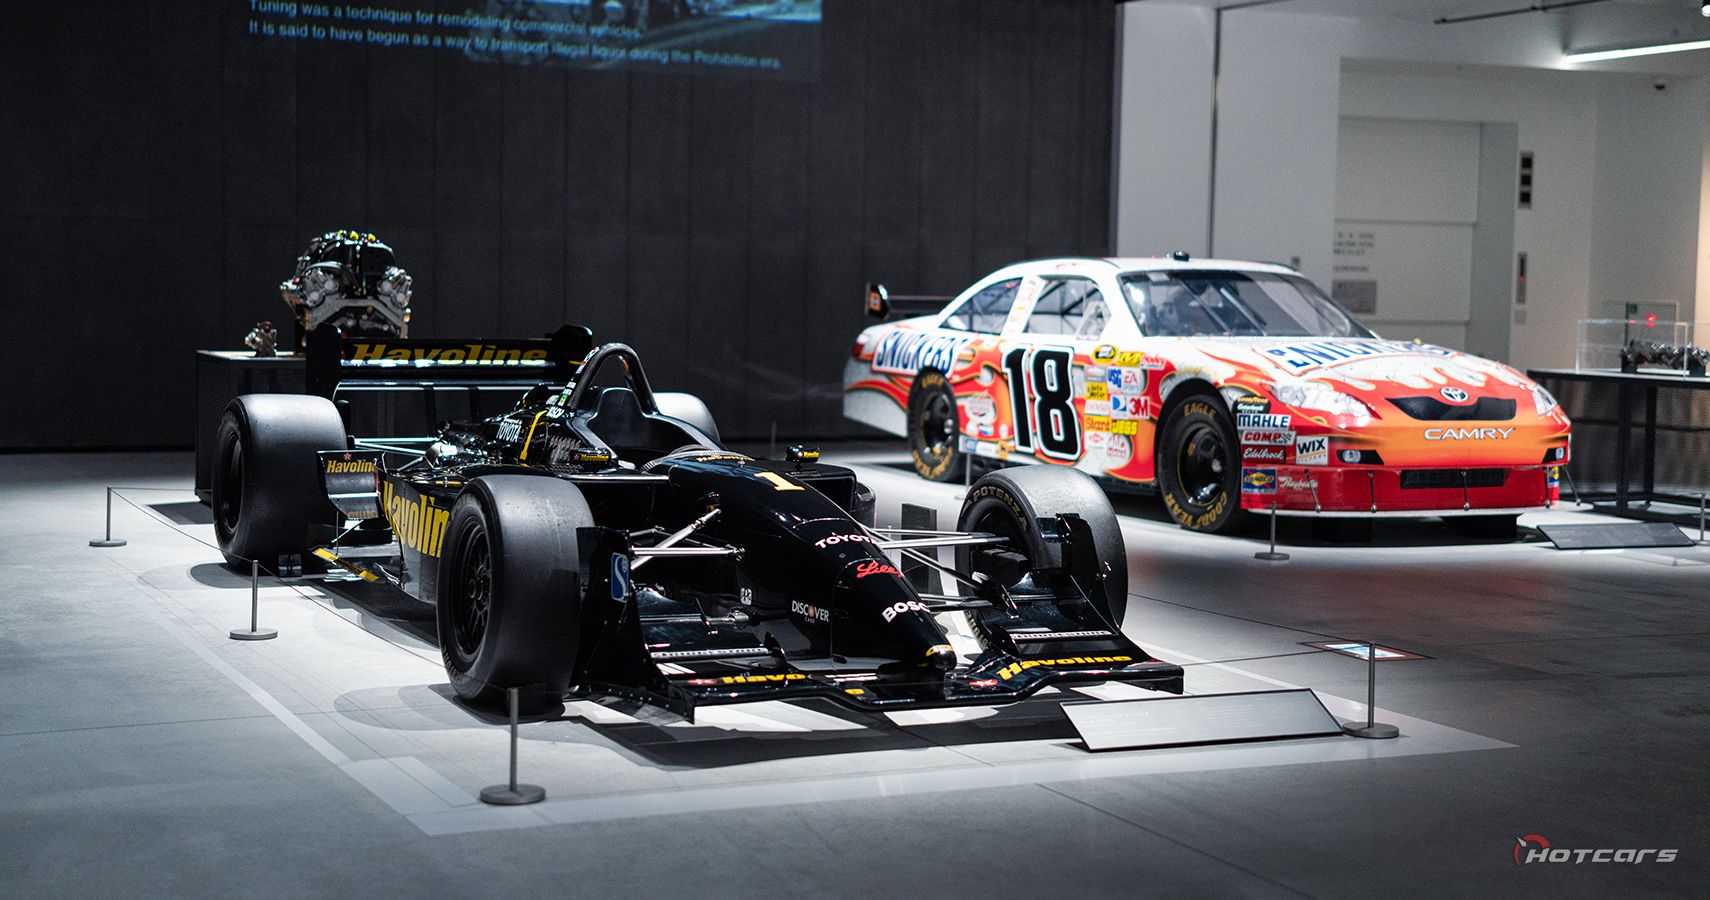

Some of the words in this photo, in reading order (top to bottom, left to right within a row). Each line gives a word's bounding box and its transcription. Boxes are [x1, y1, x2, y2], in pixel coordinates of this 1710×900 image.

[250, 0, 298, 18] Tuning
[302, 3, 330, 17] was
[333, 6, 342, 18] a
[346, 5, 413, 25] technique
[415, 9, 434, 25] for
[437, 13, 511, 33] remodeling
[249, 19, 259, 34] It
[263, 21, 275, 35] is
[279, 22, 309, 38] said
[312, 25, 327, 39] to
[330, 25, 364, 42] have
[367, 28, 410, 48] begun
[413, 33, 430, 46] as
[433, 35, 442, 48] a
[445, 36, 472, 54] way
[475, 36, 489, 51] to
[490, 37, 549, 55] transport
[671, 49, 692, 64] the
[352, 343, 548, 364] Havoline
[876, 330, 968, 375] SNICKERS
[1002, 345, 1083, 461] 18
[1129, 397, 1149, 417] 3M
[1183, 402, 1218, 419] EAGLE
[1084, 417, 1111, 432] Stant
[1237, 414, 1290, 429] MAHLE
[496, 421, 522, 443] TOYOTA
[1243, 431, 1282, 442] COMP
[1423, 427, 1516, 441] CAMRY
[1243, 447, 1285, 461] Edelbrock
[1297, 438, 1327, 456] WIX
[753, 471, 806, 491] 1
[1243, 473, 1276, 485] SUNOCO
[972, 485, 1028, 532] POTENZA
[382, 479, 450, 559] Havolin
[791, 599, 831, 623] DISCOVER
[882, 600, 932, 623] BOSC
[995, 655, 1133, 681] Havoline
[721, 673, 807, 685] Havo
